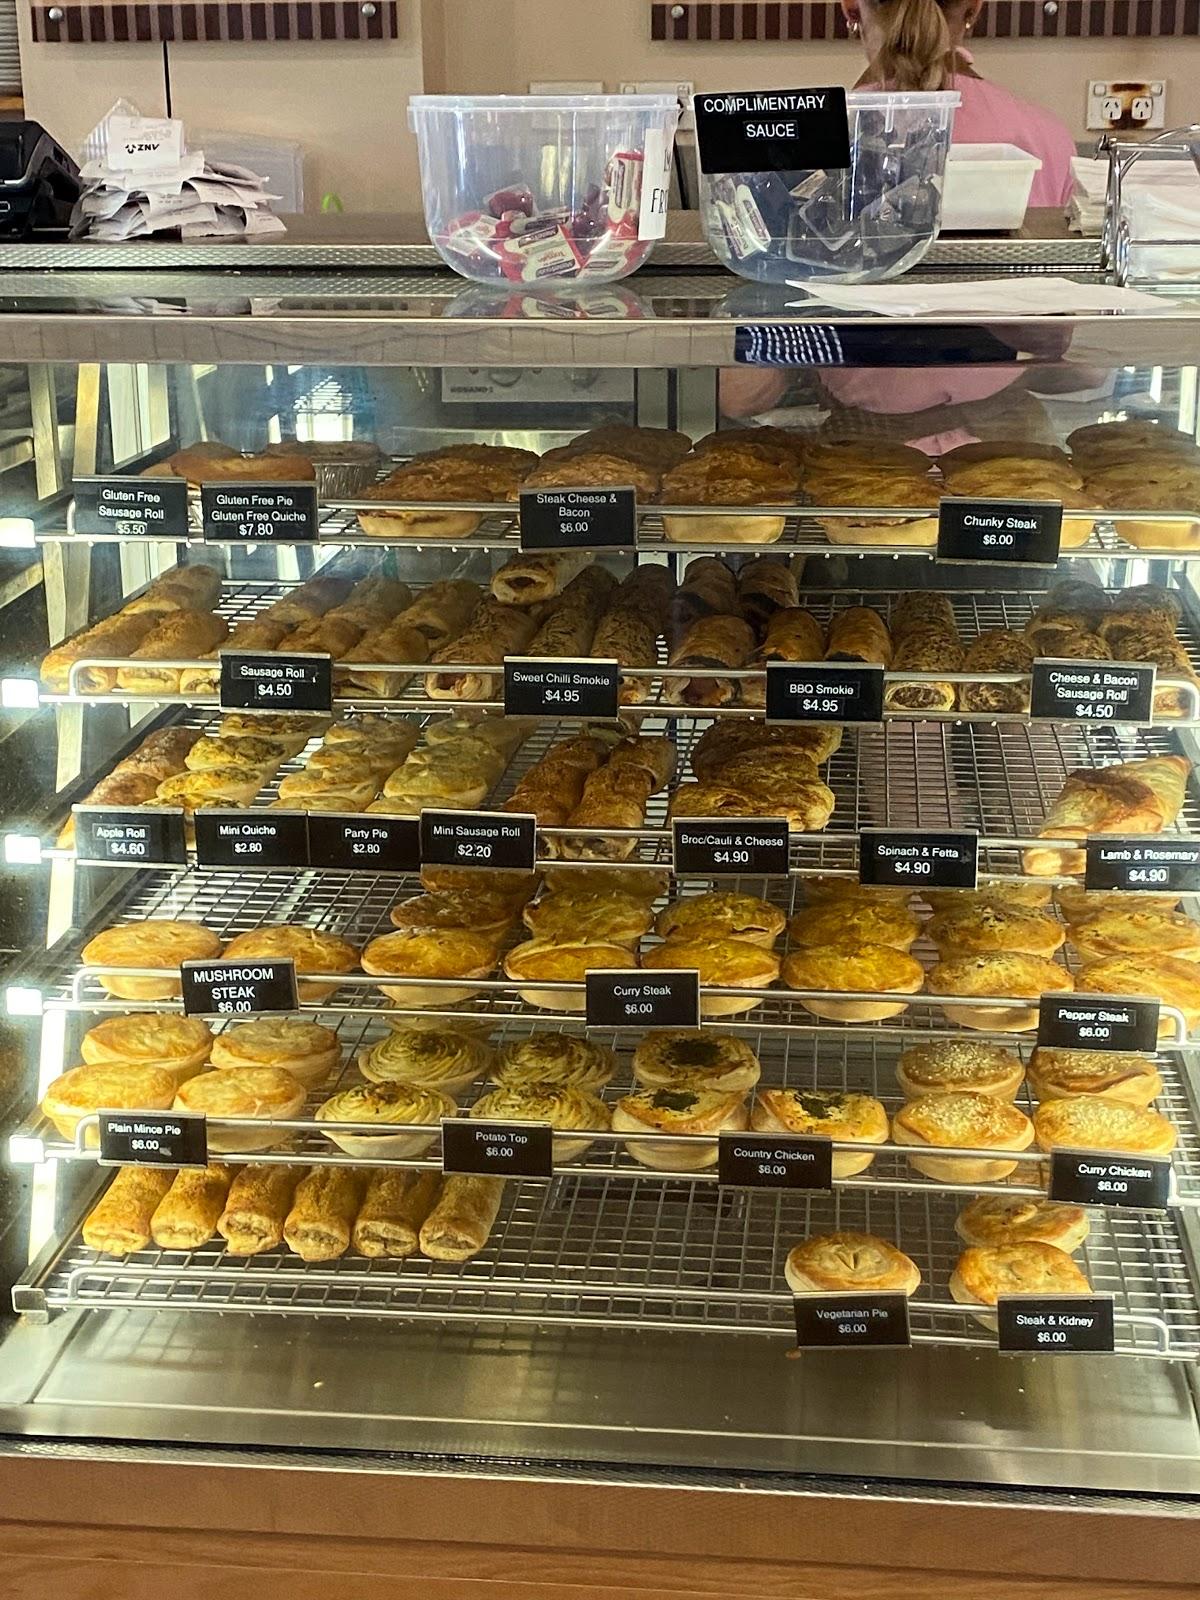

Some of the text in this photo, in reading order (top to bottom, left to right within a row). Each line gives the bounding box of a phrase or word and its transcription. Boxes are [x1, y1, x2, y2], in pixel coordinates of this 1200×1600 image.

[703, 95, 826, 113] COMPLIMENTARY
[746, 123, 795, 137] SAUCE
[138, 143, 160, 151] ANZ
[102, 490, 160, 502] Gluten Free
[216, 495, 293, 506] Gluten Free Pie
[537, 494, 617, 503] Steak Cheese &
[99, 507, 164, 519] Sausage Roll
[211, 511, 306, 522] Gluten Free Quiche
[559, 507, 590, 517] Bacon
[560, 522, 589, 533] $6.00
[964, 516, 1037, 529] Chunky Steak
[117, 524, 146, 534] $5.50
[239, 523, 273, 536] $7.80
[983, 534, 1013, 545] $6.00
[240, 666, 304, 678] Sausage Roll
[513, 672, 610, 685] Sweet Chilli Smokie
[1049, 673, 1138, 686] Cheese & Bacon
[258, 683, 292, 696] $4.50
[789, 684, 854, 695] BBQ Smokie
[1056, 688, 1127, 701] Sausage Roll
[545, 690, 580, 702] $4.95
[803, 699, 838, 712] $4.95
[1075, 704, 1113, 718] $4.50
[96, 827, 145, 839] Apple Roll
[220, 826, 276, 836] Mini Quiche
[344, 828, 388, 839] Party Pie
[433, 825, 520, 837] Mini Sausage Roll
[681, 835, 783, 846] Broc/Cauli & Cheese
[111, 842, 145, 855] $4.60
[234, 842, 262, 853] $2.80
[352, 844, 380, 854] $2.80
[458, 844, 491, 858] $2.20
[878, 845, 958, 858] Spinach & Fetta
[714, 851, 749, 863] $4.90
[1100, 850, 1198, 861] Lamb & Rosemary
[895, 862, 930, 874] $4.90
[1129, 869, 1167, 881] $4.90
[193, 968, 273, 983] MUSHROOM
[212, 986, 255, 999] STEAK
[613, 986, 672, 997] Curry Steak
[218, 1001, 251, 1013] $6.00
[625, 1004, 652, 1015] $6.00
[1058, 1009, 1129, 1023] Pepper Steak
[1079, 1026, 1109, 1037] $6.00
[108, 1123, 181, 1135] Plain Mince Pie
[475, 1132, 528, 1144] Potato Top
[486, 1147, 513, 1157] $6.00
[734, 1148, 815, 1161] Country Chicken
[758, 1164, 786, 1175] $6.00
[1078, 1164, 1152, 1178] Curry Chicken
[1098, 1181, 1128, 1192] $6.00
[816, 1309, 888, 1319] Vegetarian Pie
[1016, 1315, 1093, 1328] Steak & Kidney
[838, 1324, 866, 1333] $6.00
[1037, 1332, 1066, 1342] $6.00
